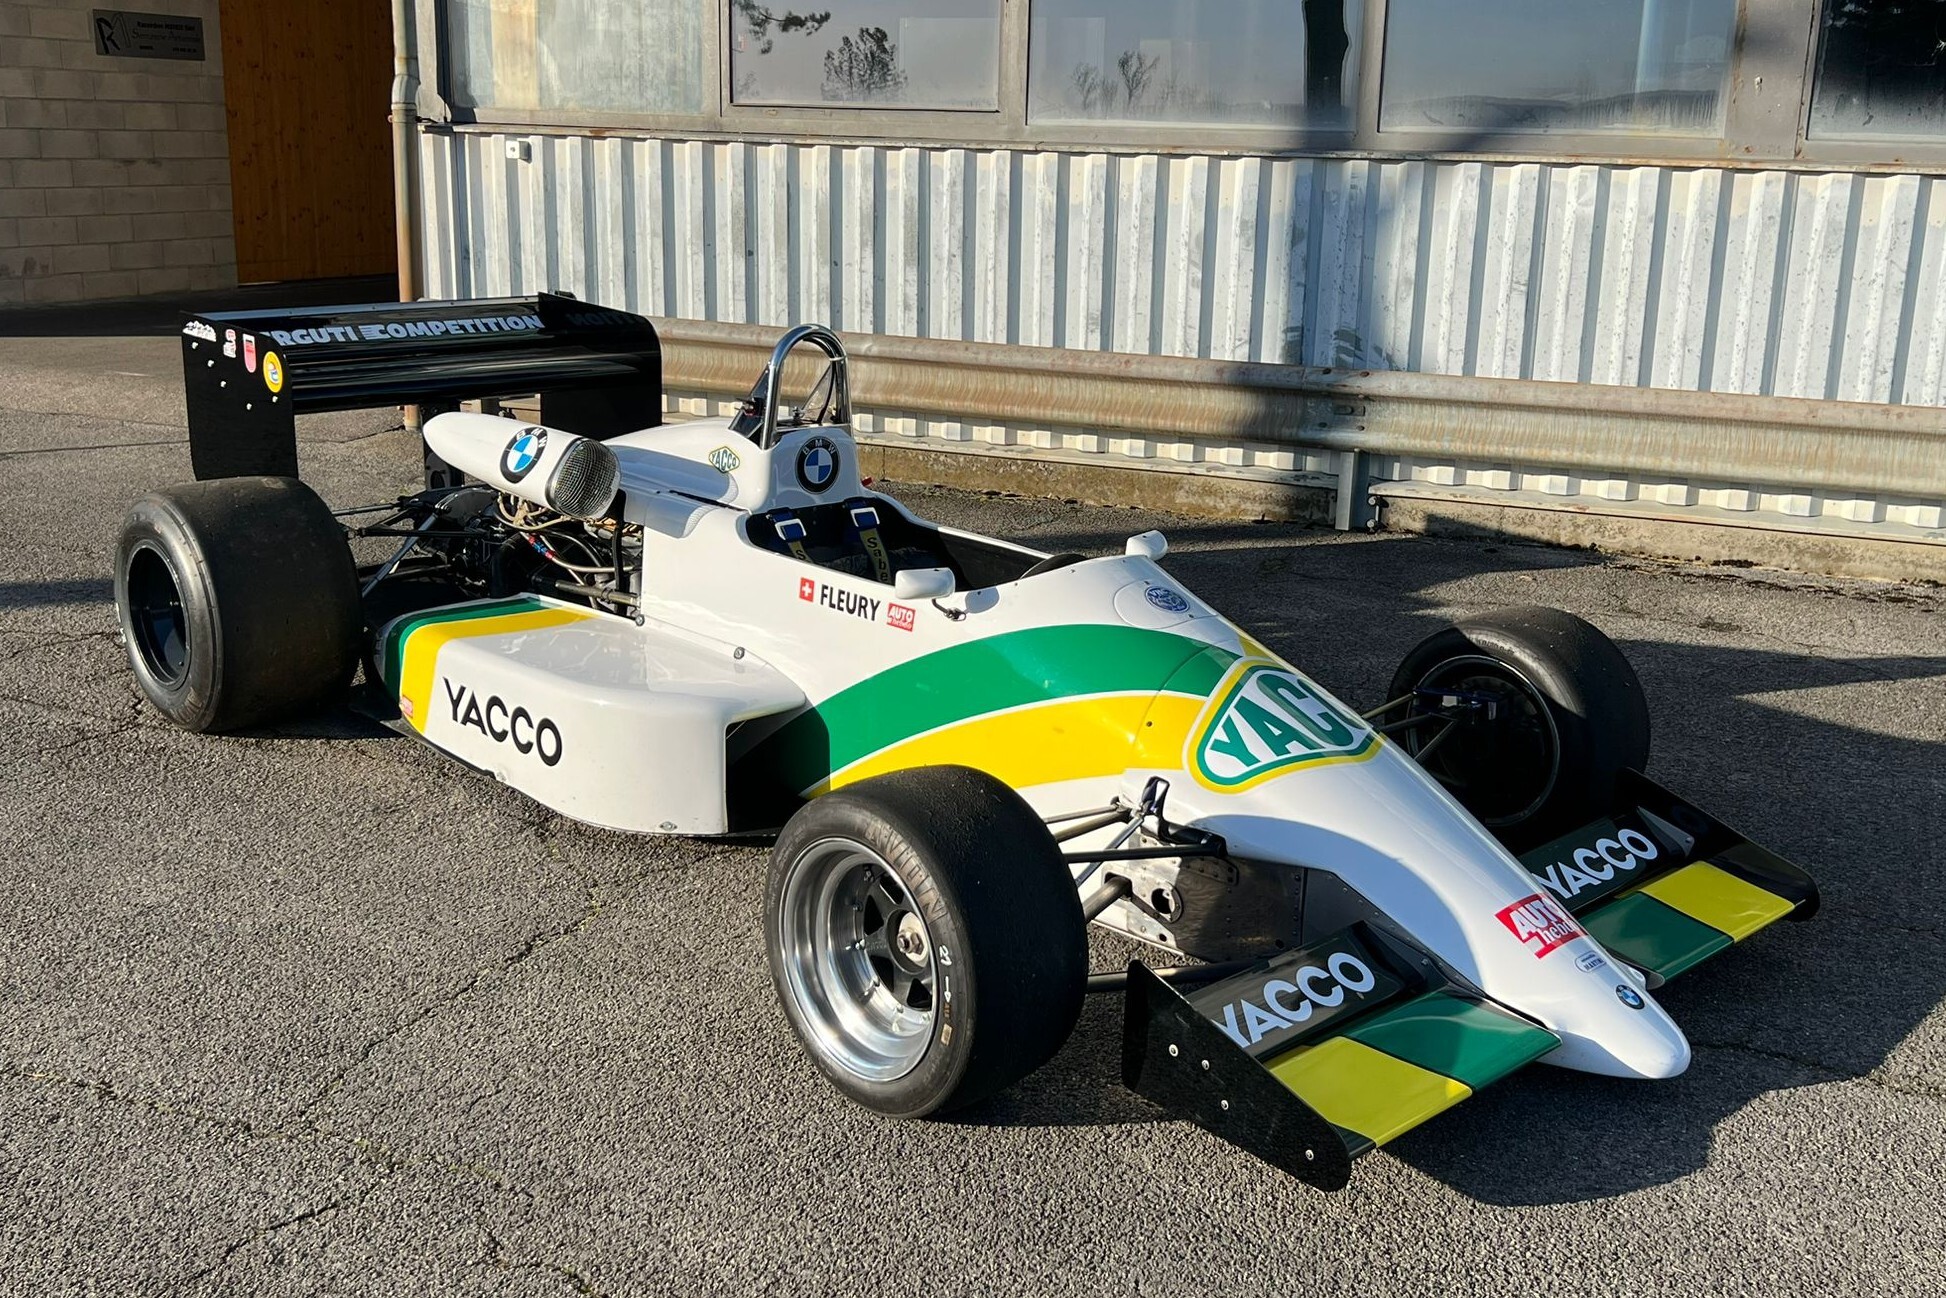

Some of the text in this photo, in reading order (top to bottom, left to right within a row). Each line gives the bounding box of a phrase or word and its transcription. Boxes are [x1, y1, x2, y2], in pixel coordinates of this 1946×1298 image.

[260, 324, 359, 347] RGUTI
[358, 314, 546, 341] COMPETITION
[711, 448, 737, 471] YACCO
[820, 584, 881, 621] FLEURY
[888, 605, 914, 624] AUTO
[443, 676, 563, 767] YACCO
[864, 819, 948, 924] AVON
[1530, 828, 1658, 899] YACCO
[1211, 952, 1376, 1048] YACCO
